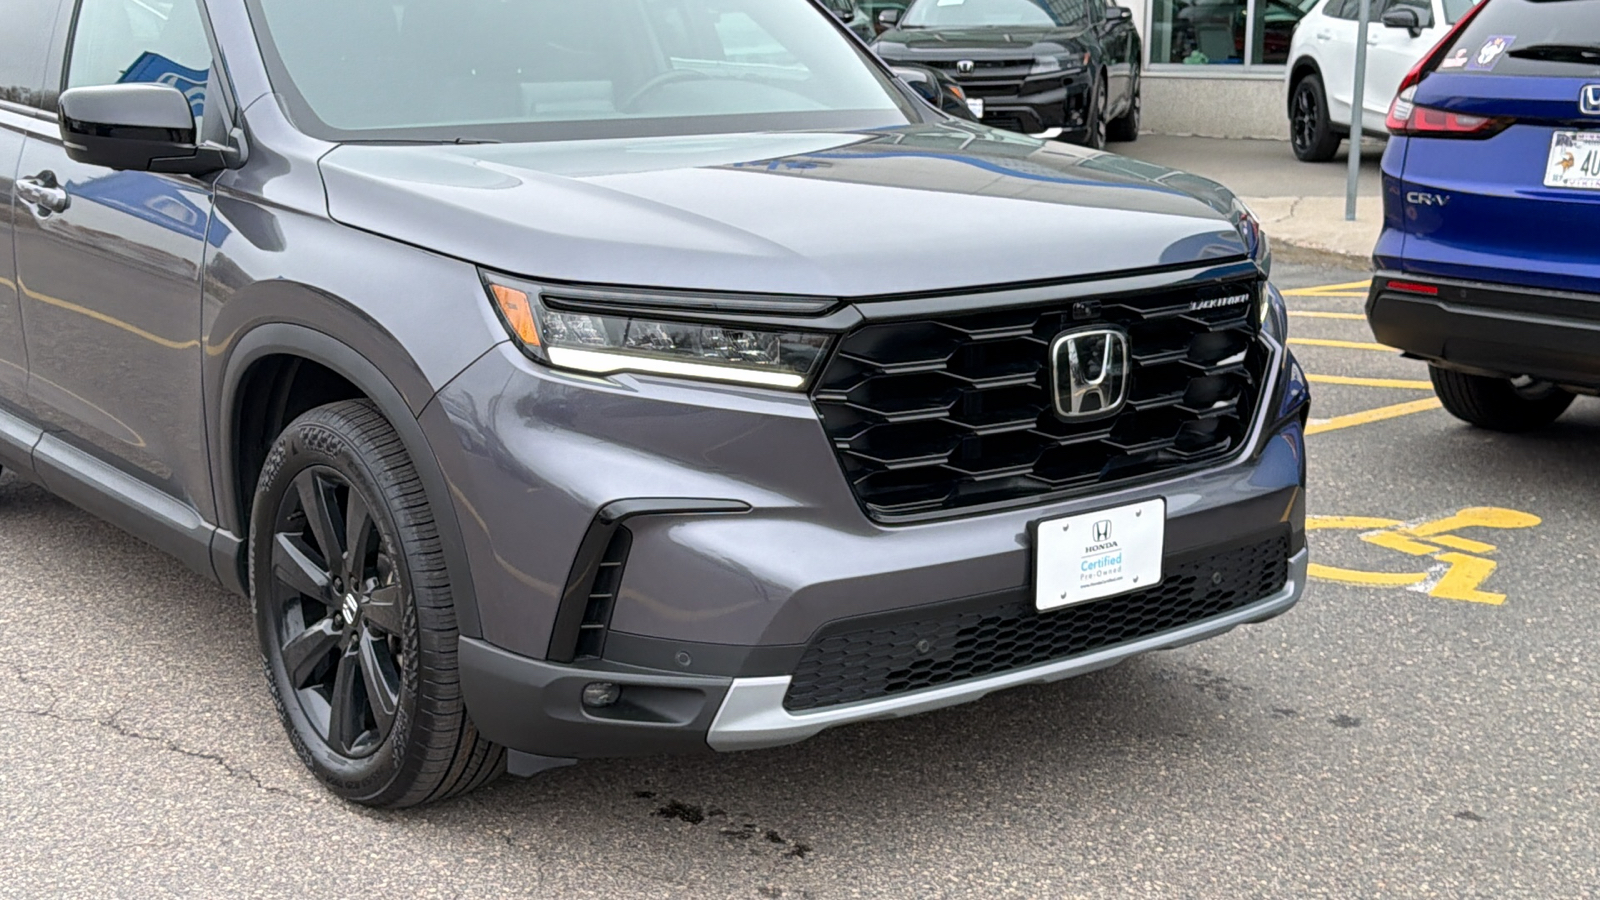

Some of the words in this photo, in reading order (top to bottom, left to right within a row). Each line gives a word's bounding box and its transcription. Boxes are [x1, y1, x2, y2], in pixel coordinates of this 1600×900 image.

[1406, 191, 1451, 206] CR-V
[1085, 541, 1118, 553] HONDA
[1080, 552, 1122, 572] Certified
[1080, 565, 1122, 581] Pre-Owned
